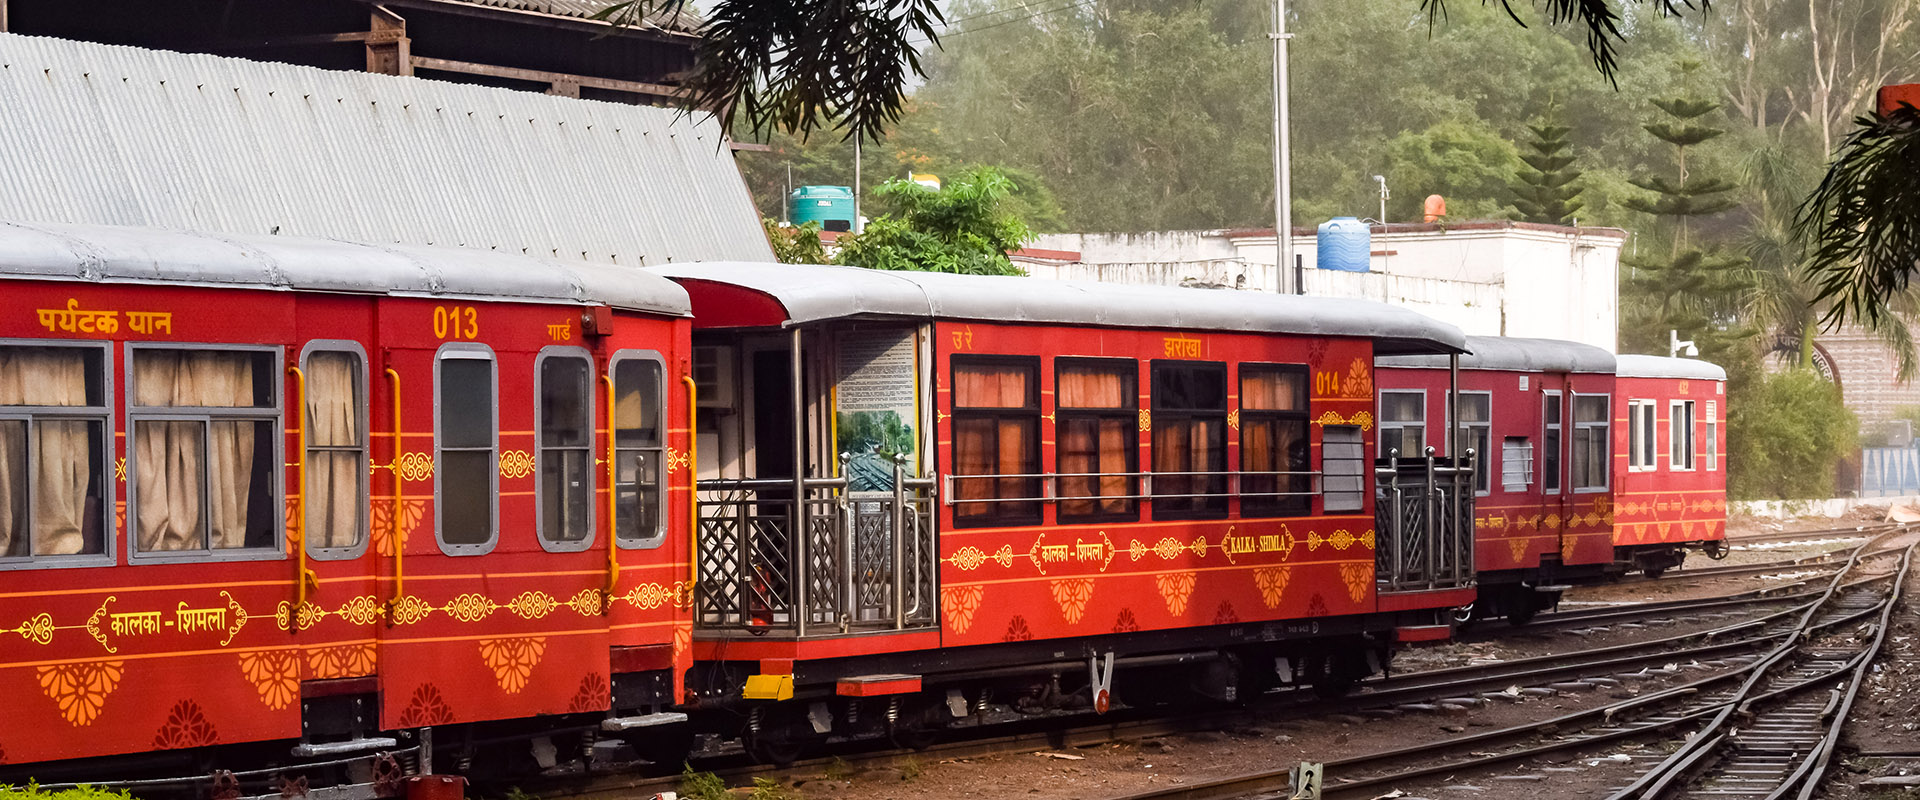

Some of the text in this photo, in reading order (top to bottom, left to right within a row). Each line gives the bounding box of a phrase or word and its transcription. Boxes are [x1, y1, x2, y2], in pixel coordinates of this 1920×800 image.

[36, 298, 172, 335] पर्यटक यान
[433, 305, 478, 340] 013
[547, 318, 571, 341] गार्ड
[1163, 331, 1201, 358] झरोखा
[1316, 370, 1339, 396] 014
[1041, 544, 1068, 563] कालका
[1076, 538, 1103, 563] शिमला
[1230, 536, 1255, 553] KALKA
[1259, 534, 1286, 552] SHIMLA
[110, 611, 162, 637] कालका
[175, 601, 226, 635] शिमला
